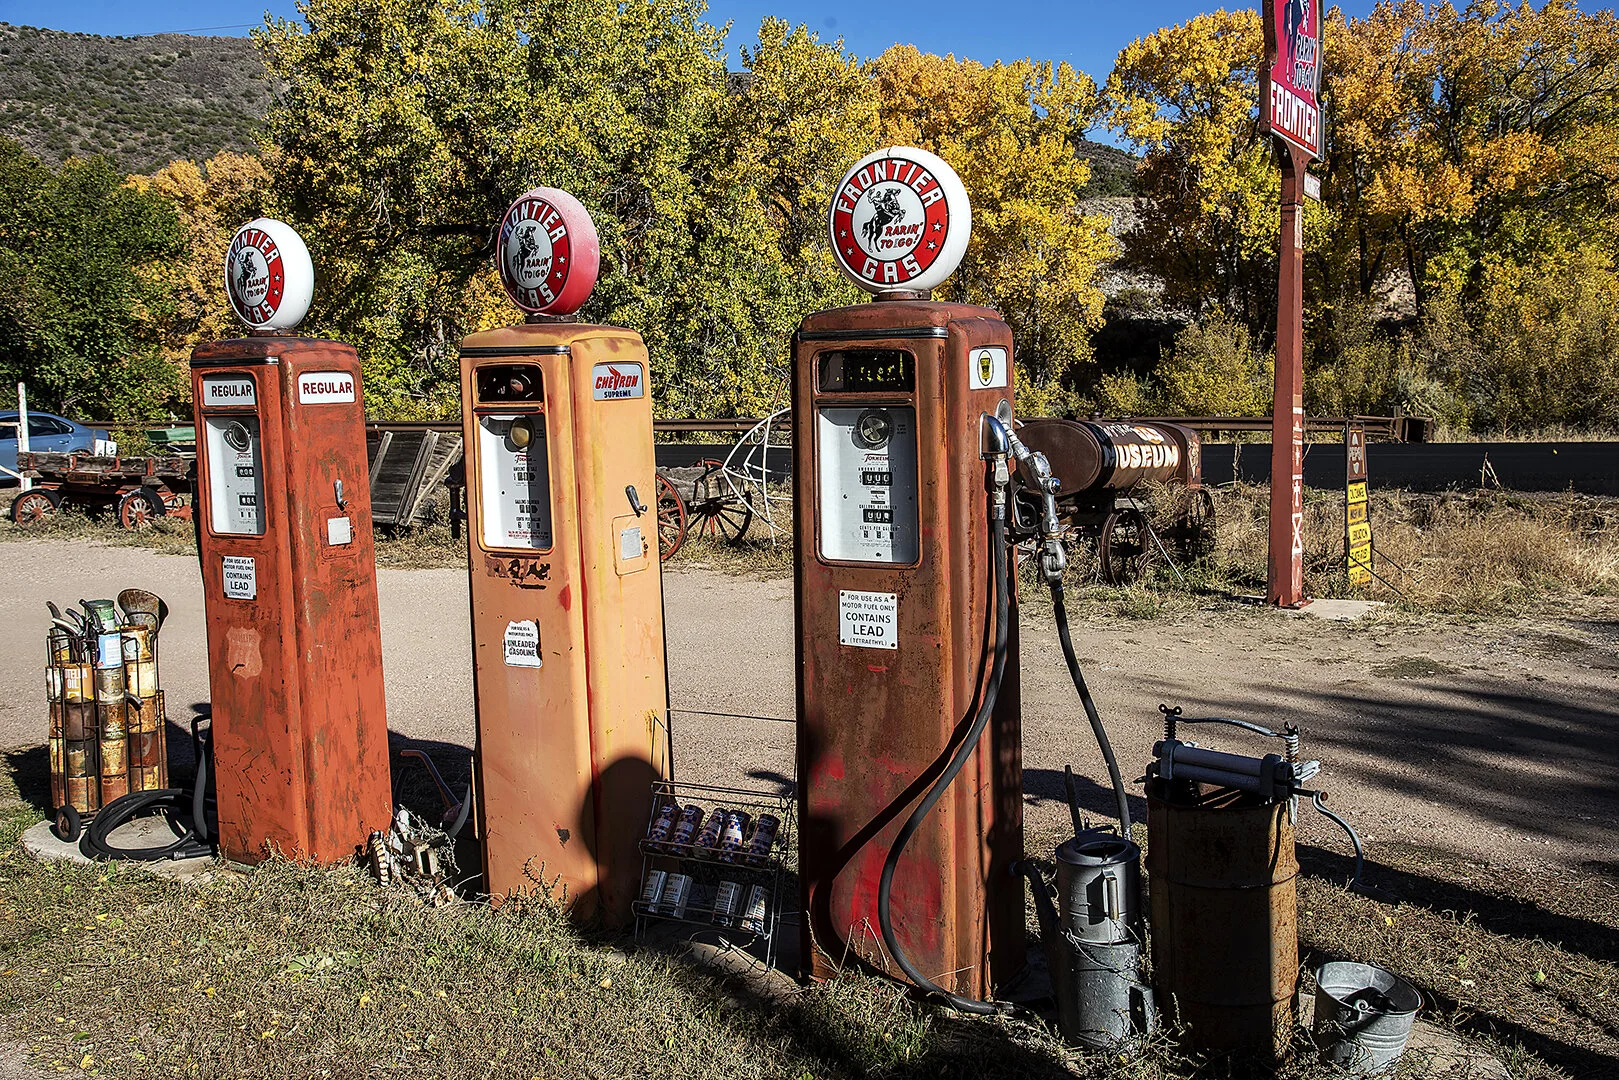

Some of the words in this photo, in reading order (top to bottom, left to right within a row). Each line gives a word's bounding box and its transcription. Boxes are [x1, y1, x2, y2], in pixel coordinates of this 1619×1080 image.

[1271, 81, 1317, 147] FRONTIER
[837, 159, 944, 214] FRONTIER
[861, 253, 922, 283] GAS
[517, 282, 555, 307] GAS
[243, 300, 275, 323] GAS
[595, 372, 639, 390] CHEVRON
[211, 385, 252, 397] REGULAR
[303, 382, 352, 394] REGULAR
[604, 390, 631, 398] SUPREME
[226, 572, 252, 580] CONTAINS
[230, 581, 249, 590] LEAD
[861, 594, 872, 602] USE
[846, 612, 891, 623] CONTAINS
[853, 624, 884, 637] LEAD
[507, 640, 535, 648] UNLEADED
[509, 648, 535, 657] GASOLINE
